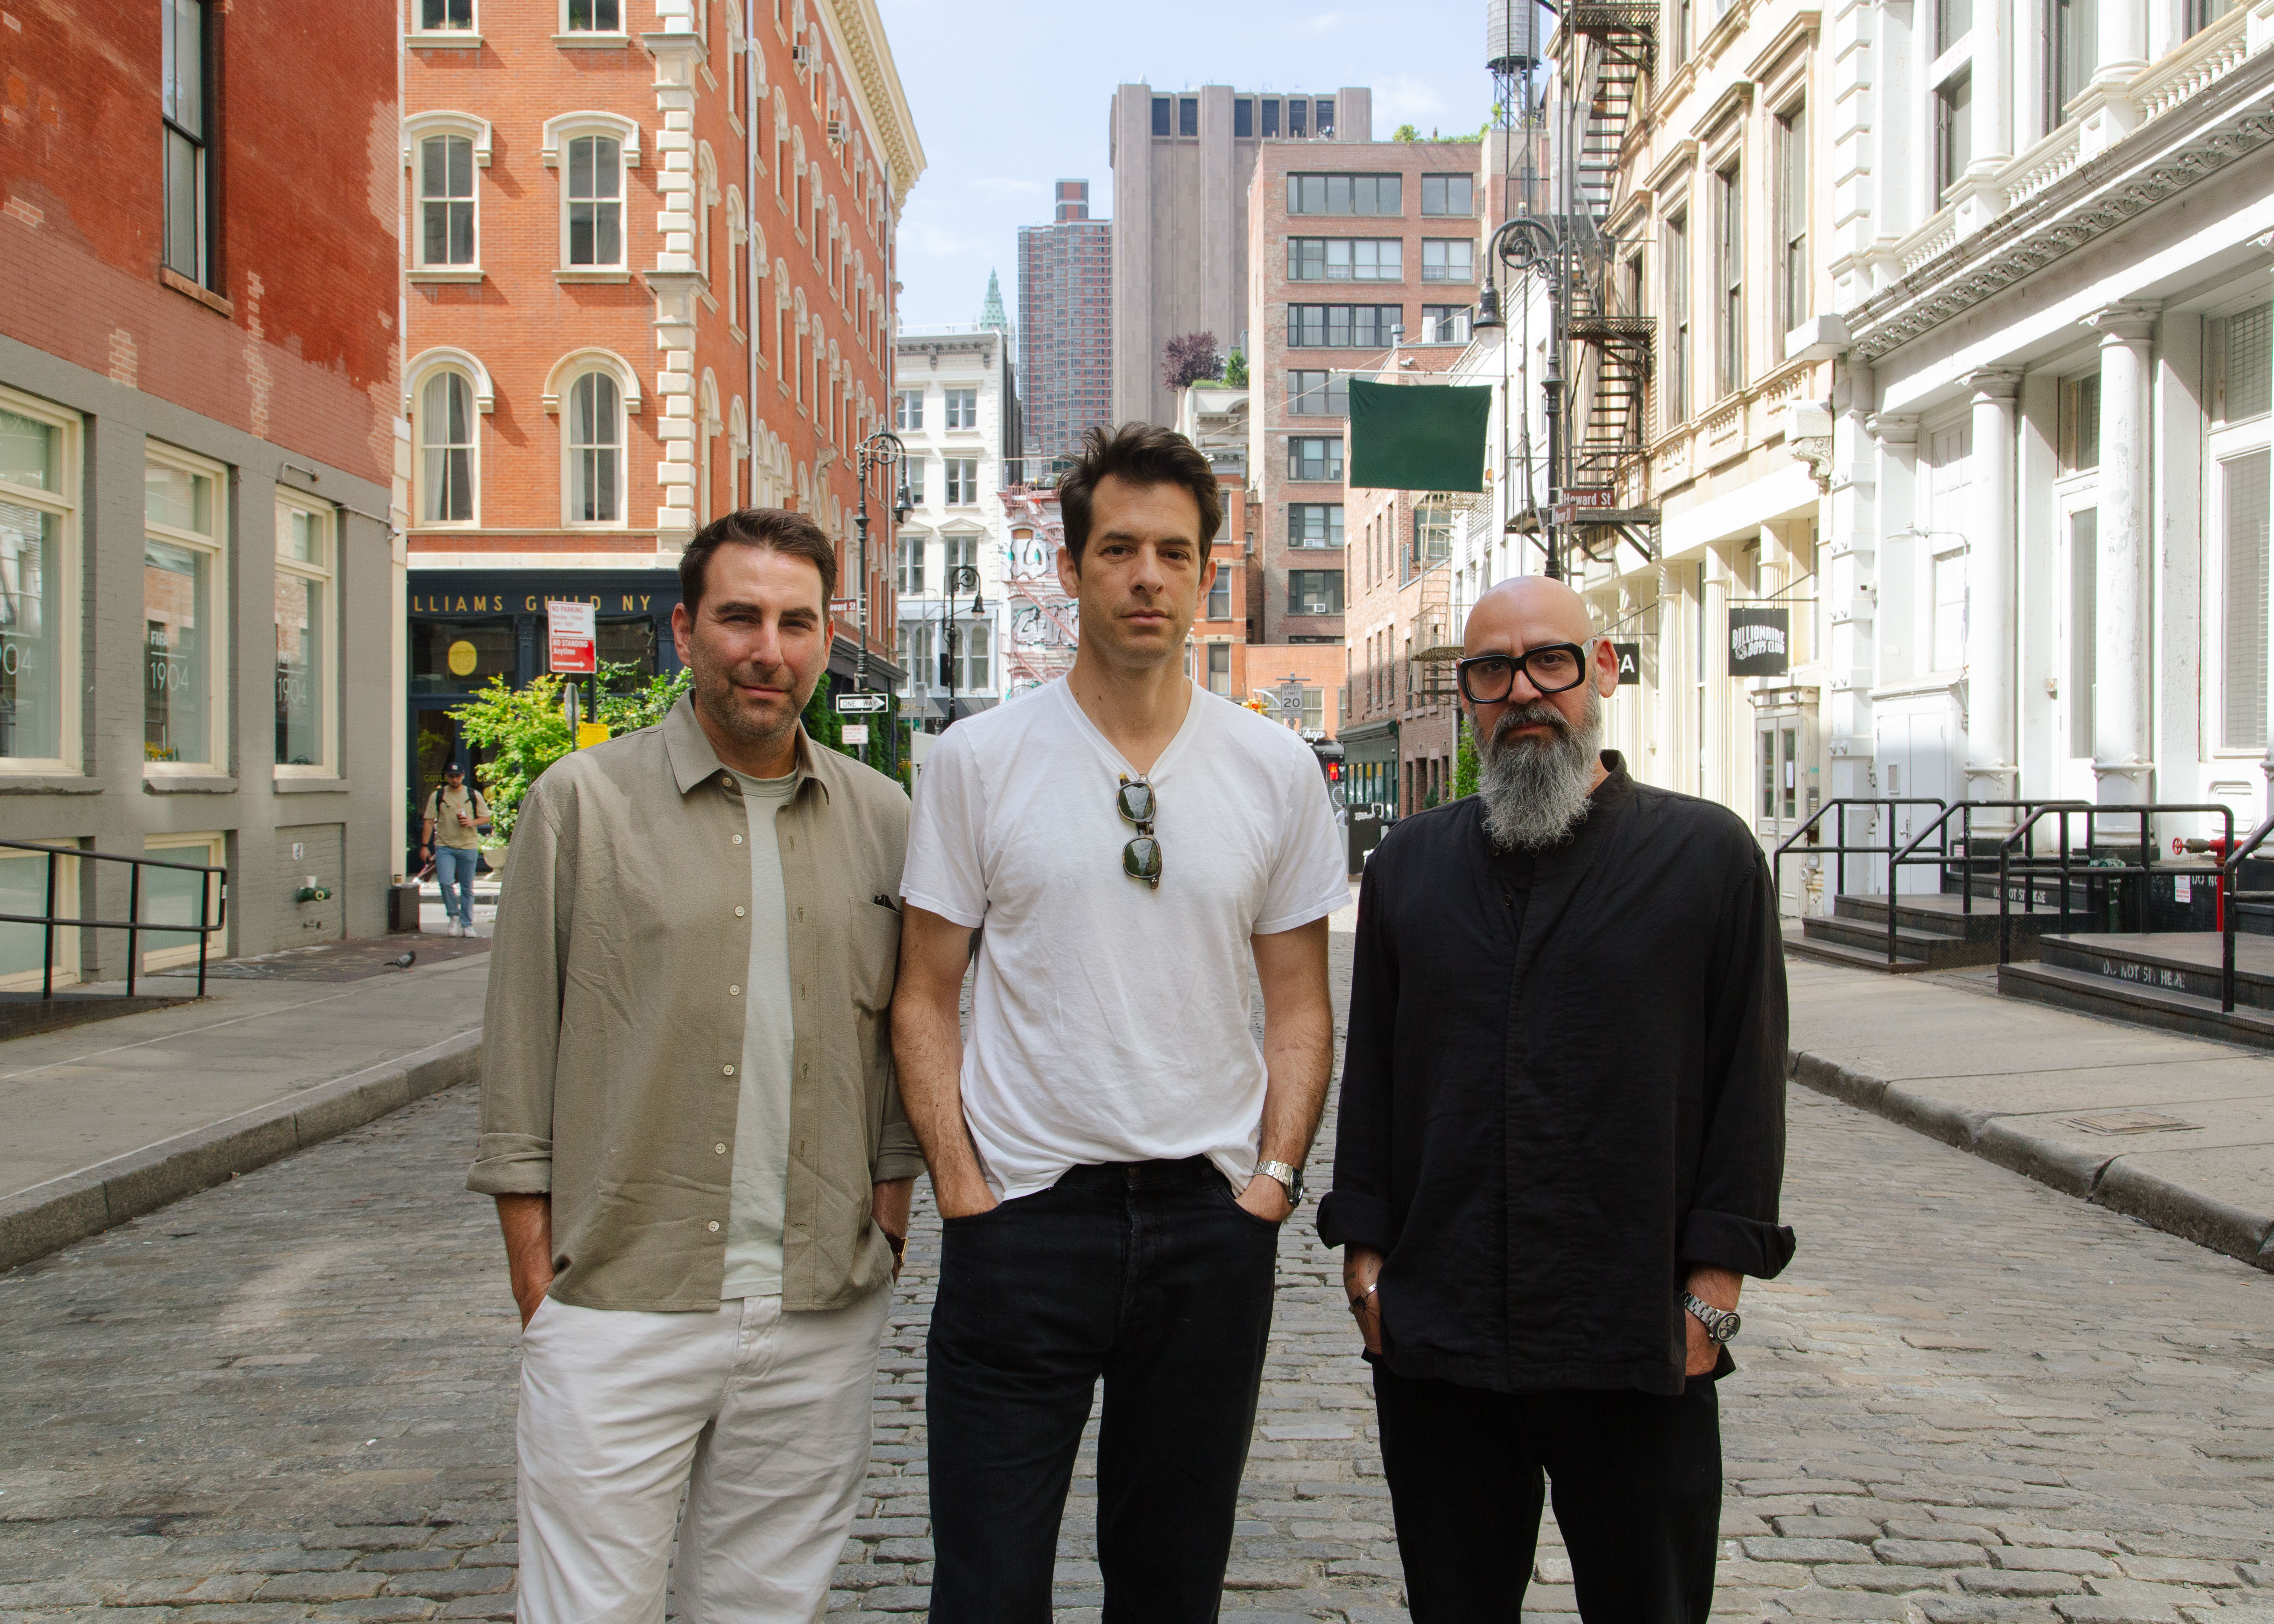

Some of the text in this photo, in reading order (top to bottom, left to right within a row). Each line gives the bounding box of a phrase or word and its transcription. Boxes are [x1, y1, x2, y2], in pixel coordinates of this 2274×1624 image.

[1563, 492, 1611, 505] Howard St
[623, 595, 650, 611] NY
[849, 602, 856, 610] St
[150, 631, 169, 646] FIFA
[562, 639, 588, 648] STANDING
[1732, 625, 1785, 649] BILLIONAIRE
[553, 647, 576, 656] Anytime
[1747, 640, 1785, 657] BOYS CLUB
[150, 661, 190, 691] 1904
[278, 677, 307, 705] 1904
[1284, 698, 1300, 708] 20
[1298, 726, 1325, 742] Shop
